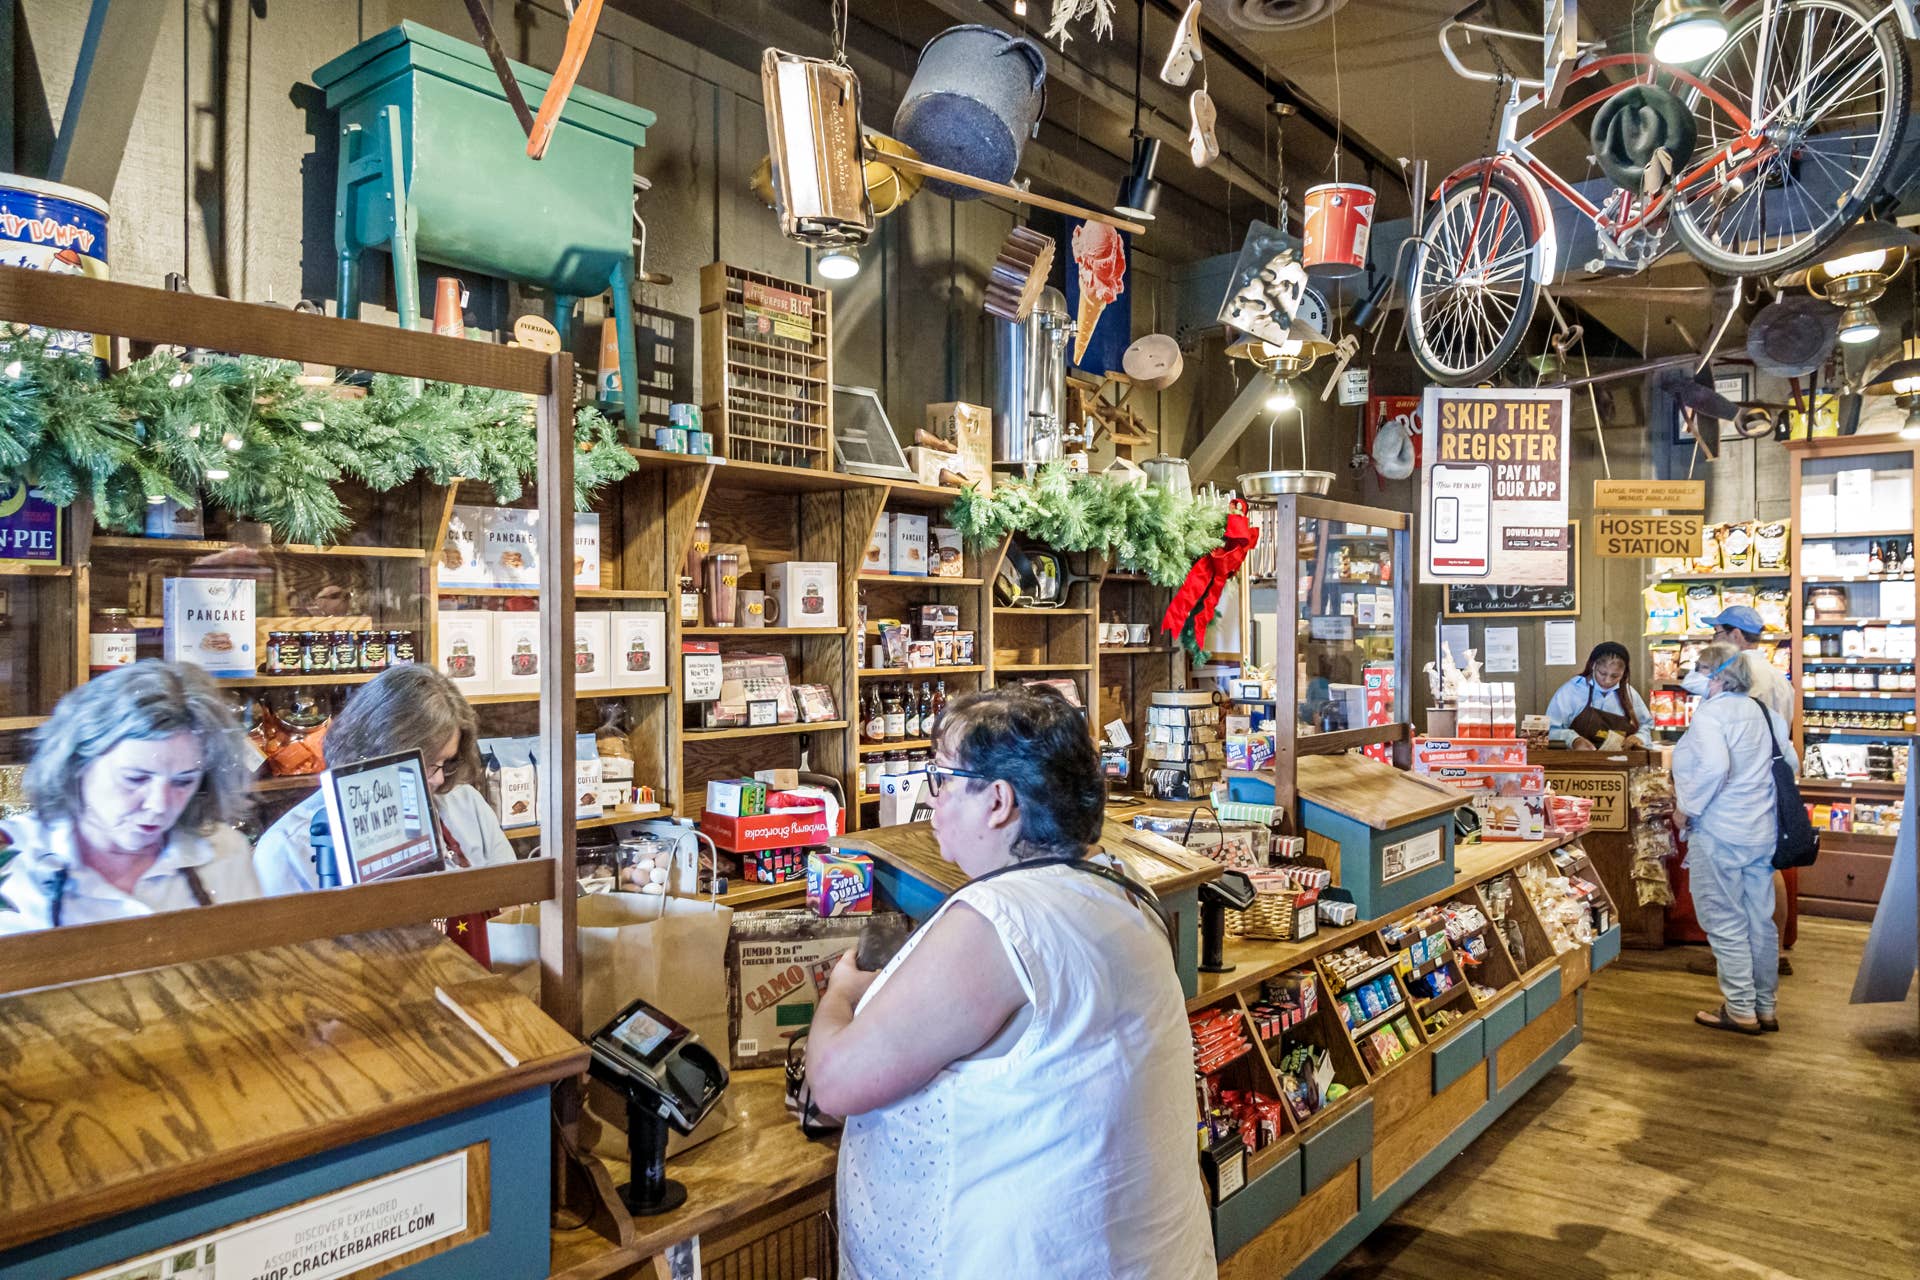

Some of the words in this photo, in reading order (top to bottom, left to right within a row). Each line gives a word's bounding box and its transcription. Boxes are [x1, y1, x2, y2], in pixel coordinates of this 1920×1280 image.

[831, 100, 842, 143] GRAND
[836, 148, 847, 192] RAPIDS
[29, 217, 95, 253] DUMPTY
[790, 297, 811, 318] RIT
[1310, 311, 1317, 320] 8
[1442, 402, 1497, 430] SKIP
[1504, 403, 1550, 431] THE
[1441, 432, 1557, 461] REGISTER
[1497, 464, 1521, 481] PAY
[1526, 464, 1541, 481] IN
[1496, 481, 1525, 496] OUR
[1528, 482, 1557, 497] APP
[1505, 528, 1543, 537] DOWNLOAD
[1544, 528, 1561, 537] NOW
[1600, 519, 1697, 535] HOSTESS
[489, 531, 534, 544] PANCAKE
[576, 536, 596, 546] UFFIN
[902, 532, 925, 543] PANCAKE
[1608, 538, 1690, 554] STATION
[187, 609, 246, 621] PANCAKE
[107, 645, 124, 653] APPLE
[1427, 741, 1450, 749] Breyer
[577, 775, 599, 785] COFFEE
[1442, 768, 1466, 776] Breyer
[508, 783, 531, 792] COFFEE
[1548, 779, 1622, 792] OST/HOSTESS
[348, 785, 370, 812] Try
[373, 779, 393, 804] Our
[352, 813, 368, 837] PAY
[371, 810, 381, 830] IN
[383, 805, 398, 827] APP
[744, 826, 790, 841] Shortcake
[831, 875, 860, 891] SUPER
[830, 882, 865, 903] DUPER
[742, 947, 773, 958] JUMBO
[775, 946, 782, 955] 3
[783, 947, 791, 955] IN
[742, 958, 775, 966] CHECKER
[776, 956, 791, 964] RUG
[745, 964, 806, 1012] CAMO
[295, 1217, 345, 1245] DISCOVER
[347, 1198, 398, 1225] EXPANDED
[264, 1237, 339, 1270] ASSORTMENTS
[339, 1231, 350, 1244] &
[353, 1210, 410, 1239] EXCLUSIVES
[407, 1203, 424, 1220] AT
[252, 1212, 436, 1280] HOP.CRACKERBARREL.COM
